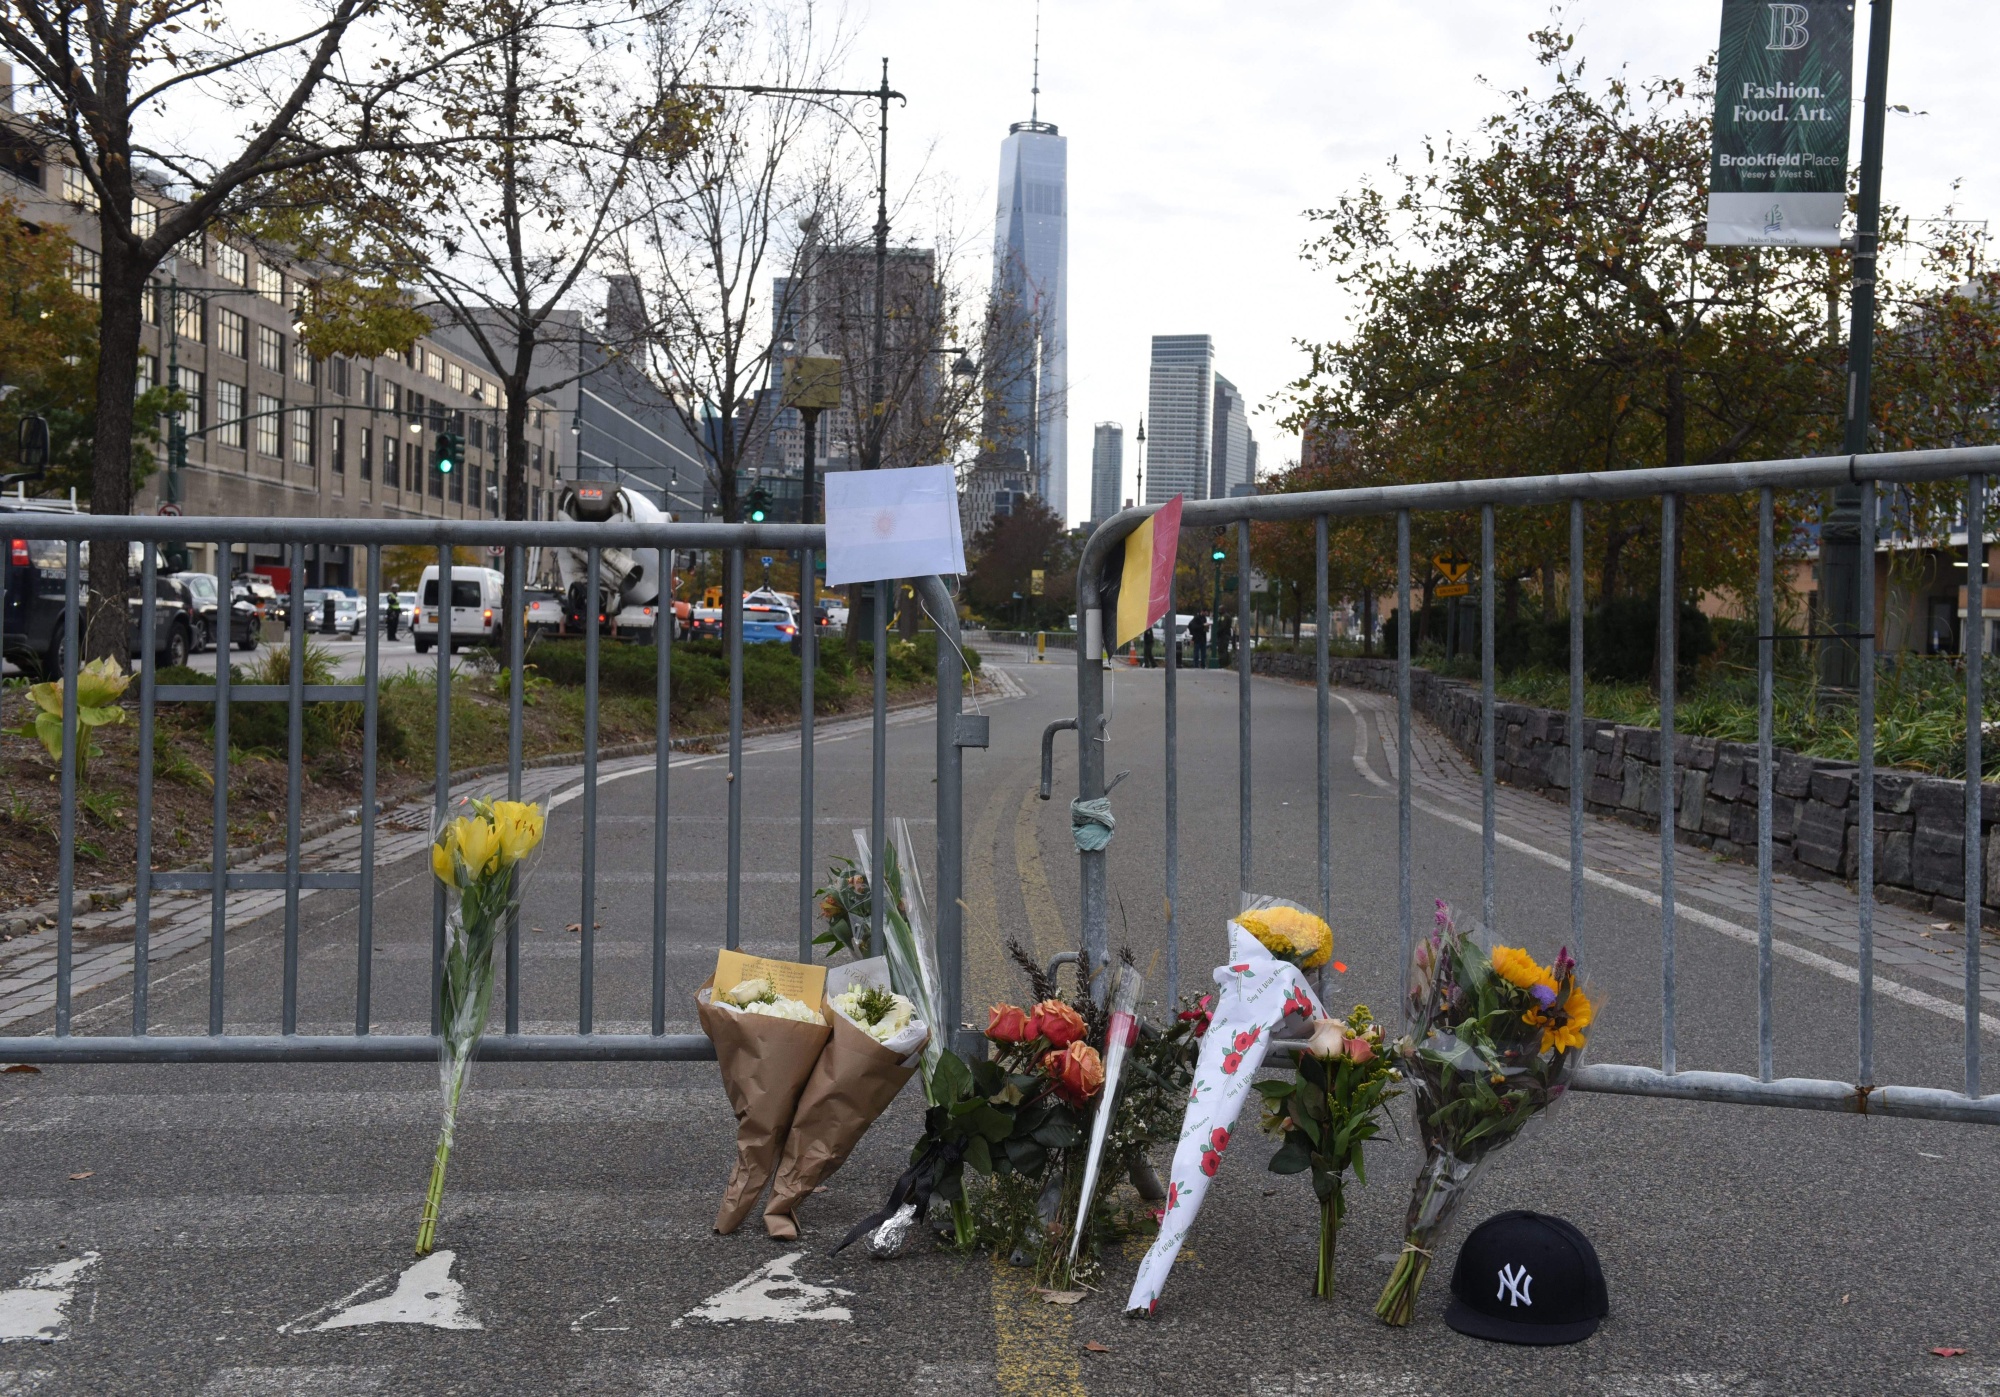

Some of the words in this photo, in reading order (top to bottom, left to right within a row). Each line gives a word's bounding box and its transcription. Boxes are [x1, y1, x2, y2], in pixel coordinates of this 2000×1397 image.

[1742, 81, 1825, 100] Fashion.
[1733, 104, 1788, 122] Food.
[1794, 105, 1832, 122] Art.
[1719, 153, 1800, 167] Brookfield
[1802, 153, 1840, 166] Place
[1741, 170, 1767, 179] Vesey
[1769, 170, 1776, 178] &
[1779, 170, 1802, 178] West
[1804, 170, 1816, 178] St.
[1247, 993, 1258, 1003] Say
[1496, 1262, 1533, 1307] NY
